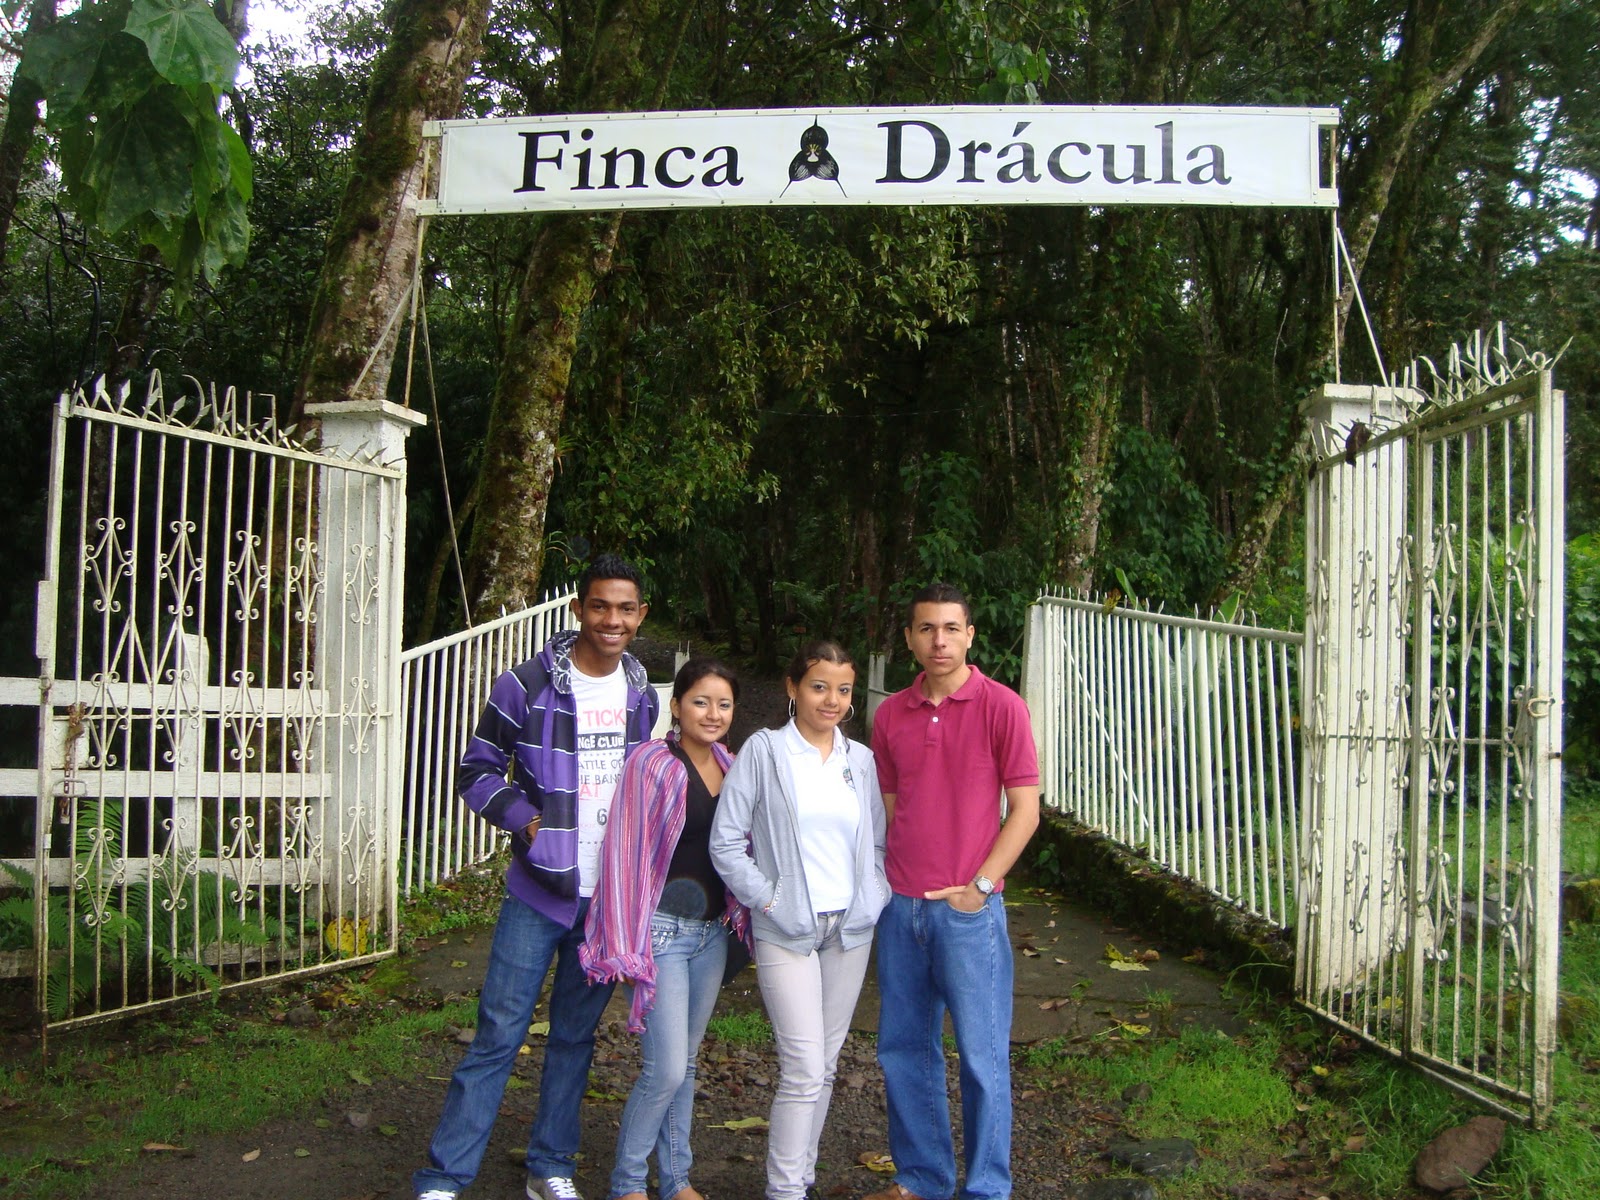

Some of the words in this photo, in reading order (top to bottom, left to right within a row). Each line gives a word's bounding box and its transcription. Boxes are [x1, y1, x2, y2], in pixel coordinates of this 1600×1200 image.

[514, 129, 744, 193] Finca
[875, 120, 1232, 185] Drácula
[597, 735, 625, 748] CLUB
[596, 808, 608, 826] 6
